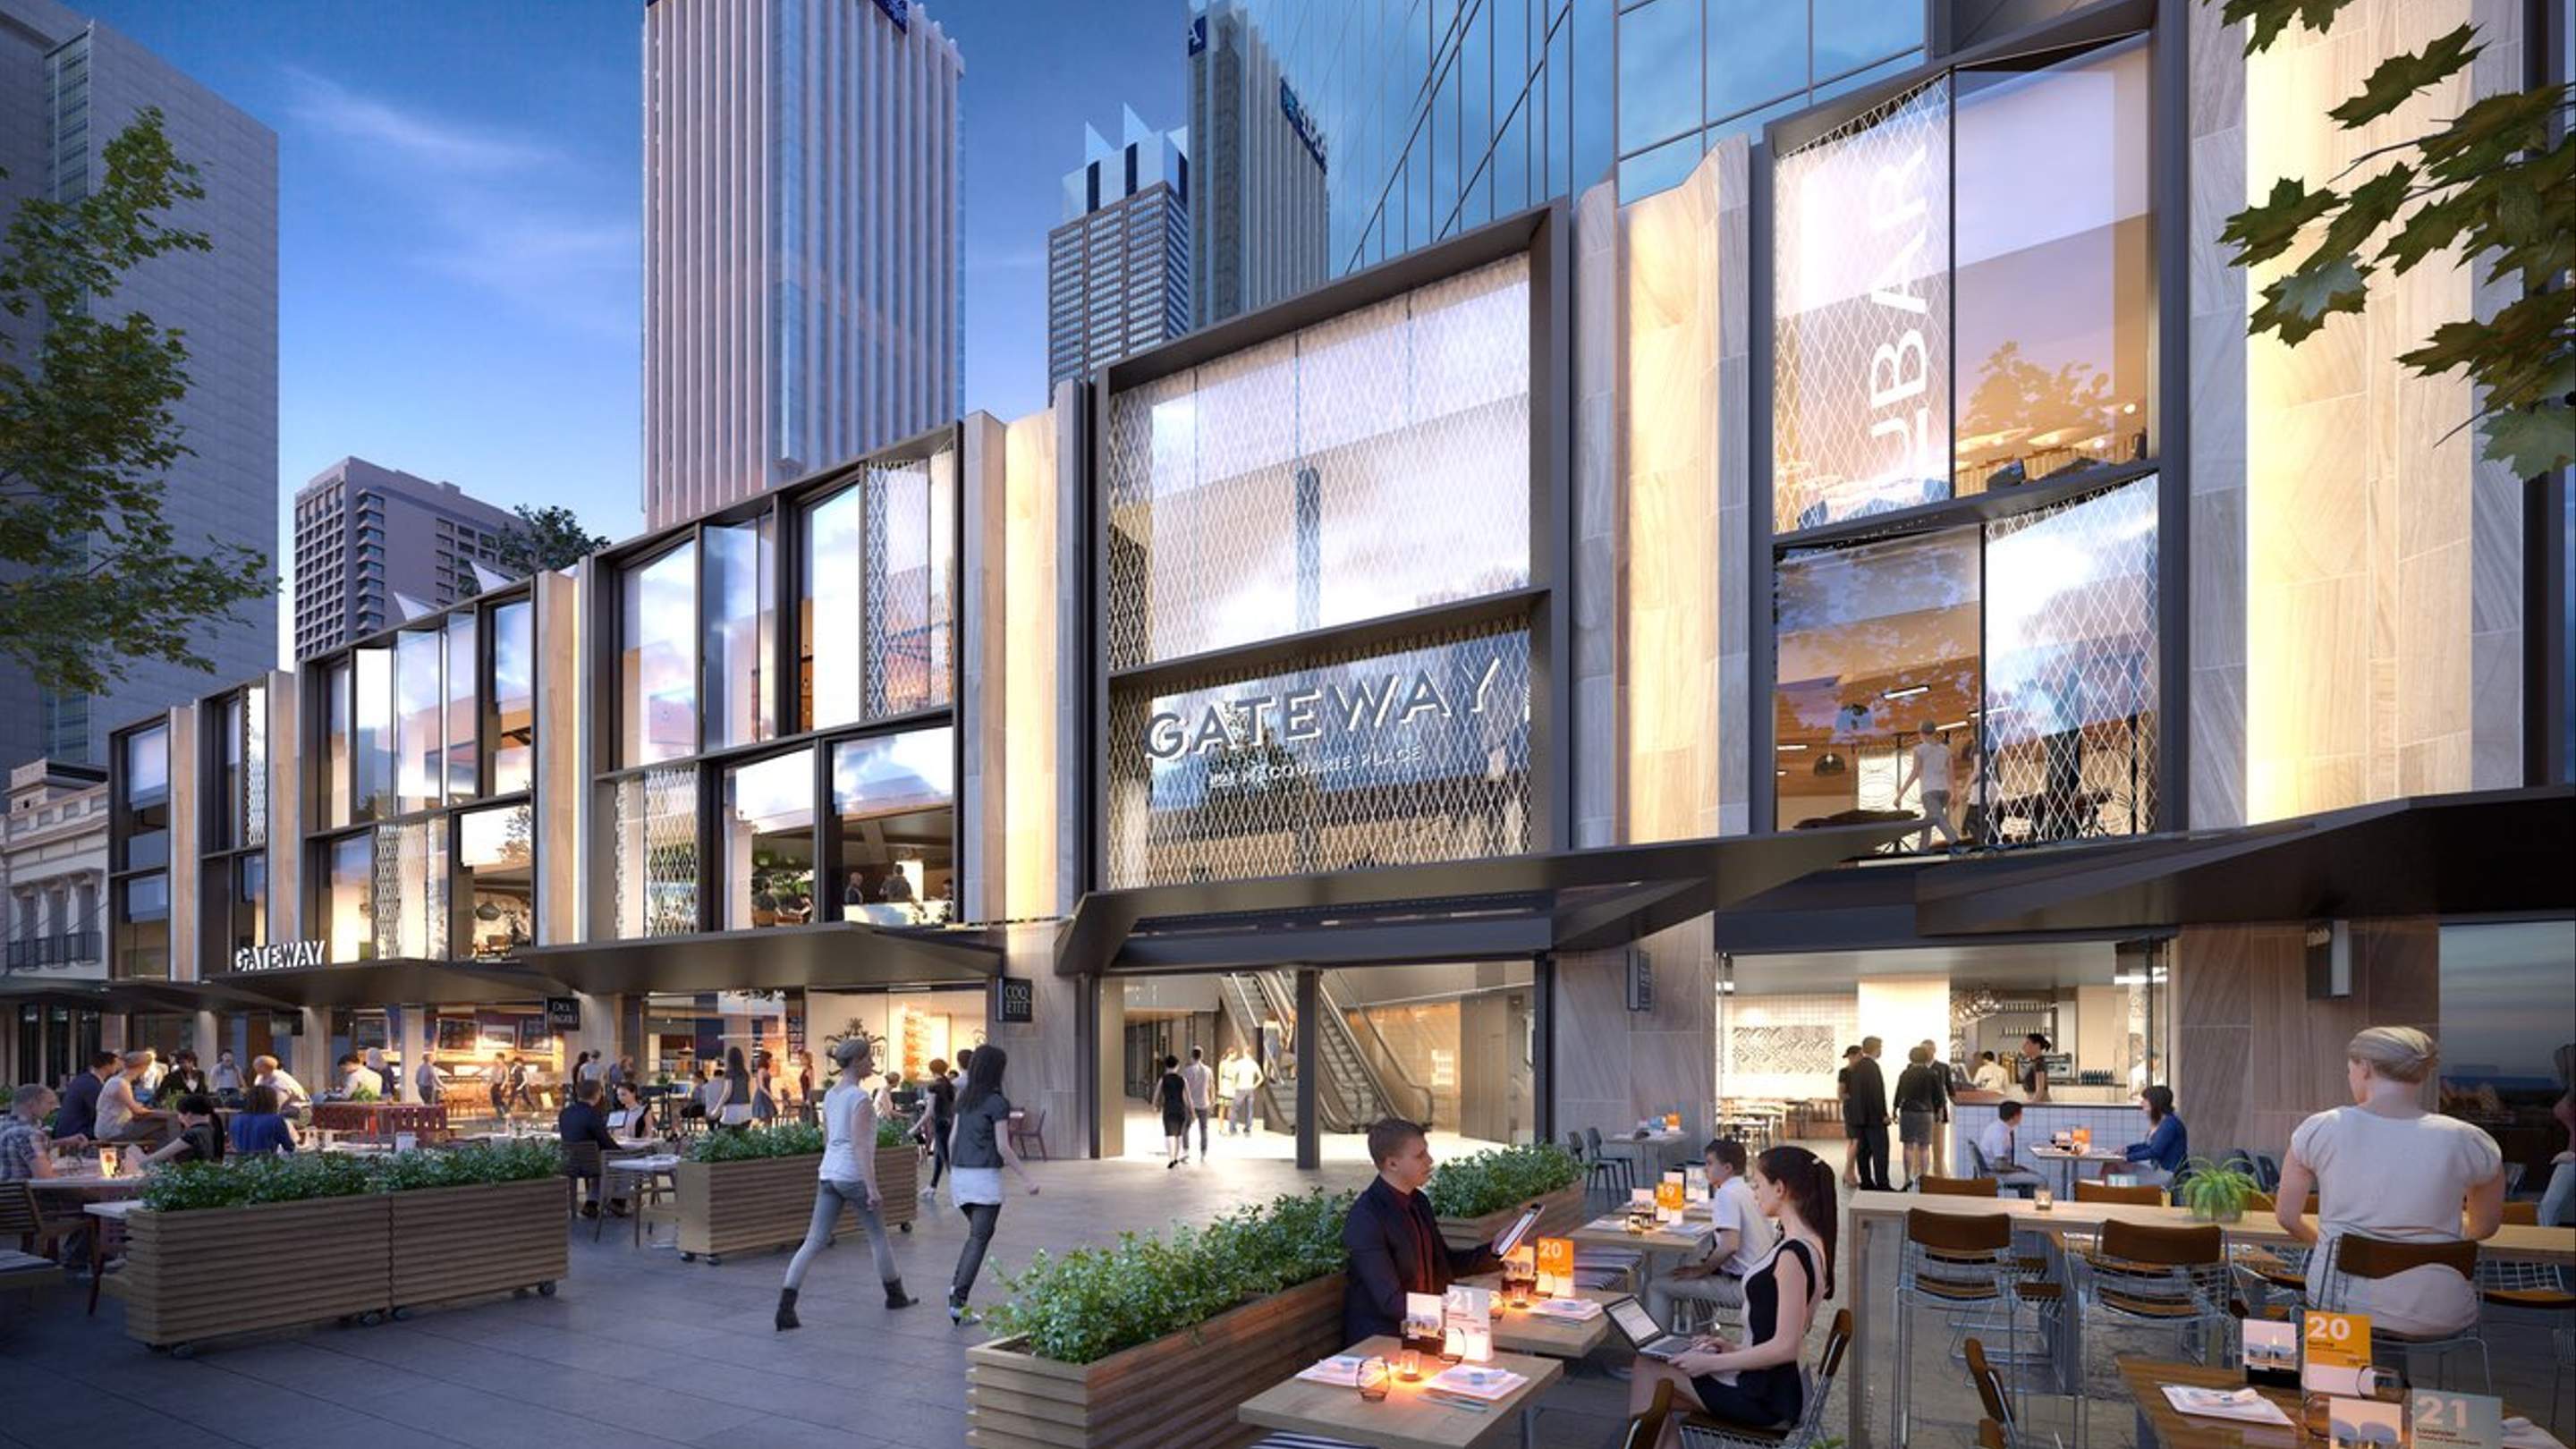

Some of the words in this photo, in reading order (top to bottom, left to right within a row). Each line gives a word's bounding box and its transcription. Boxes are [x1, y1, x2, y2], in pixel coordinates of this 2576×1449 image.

[1144, 657, 1501, 761] GATEWAY
[1361, 745, 1422, 767] PLACE
[235, 940, 326, 971] GATEWAY
[1539, 1241, 1563, 1259] 20
[1448, 1290, 1473, 1312] 21
[2309, 1316, 2351, 1340] 20
[2417, 1395, 2468, 1428] 21
